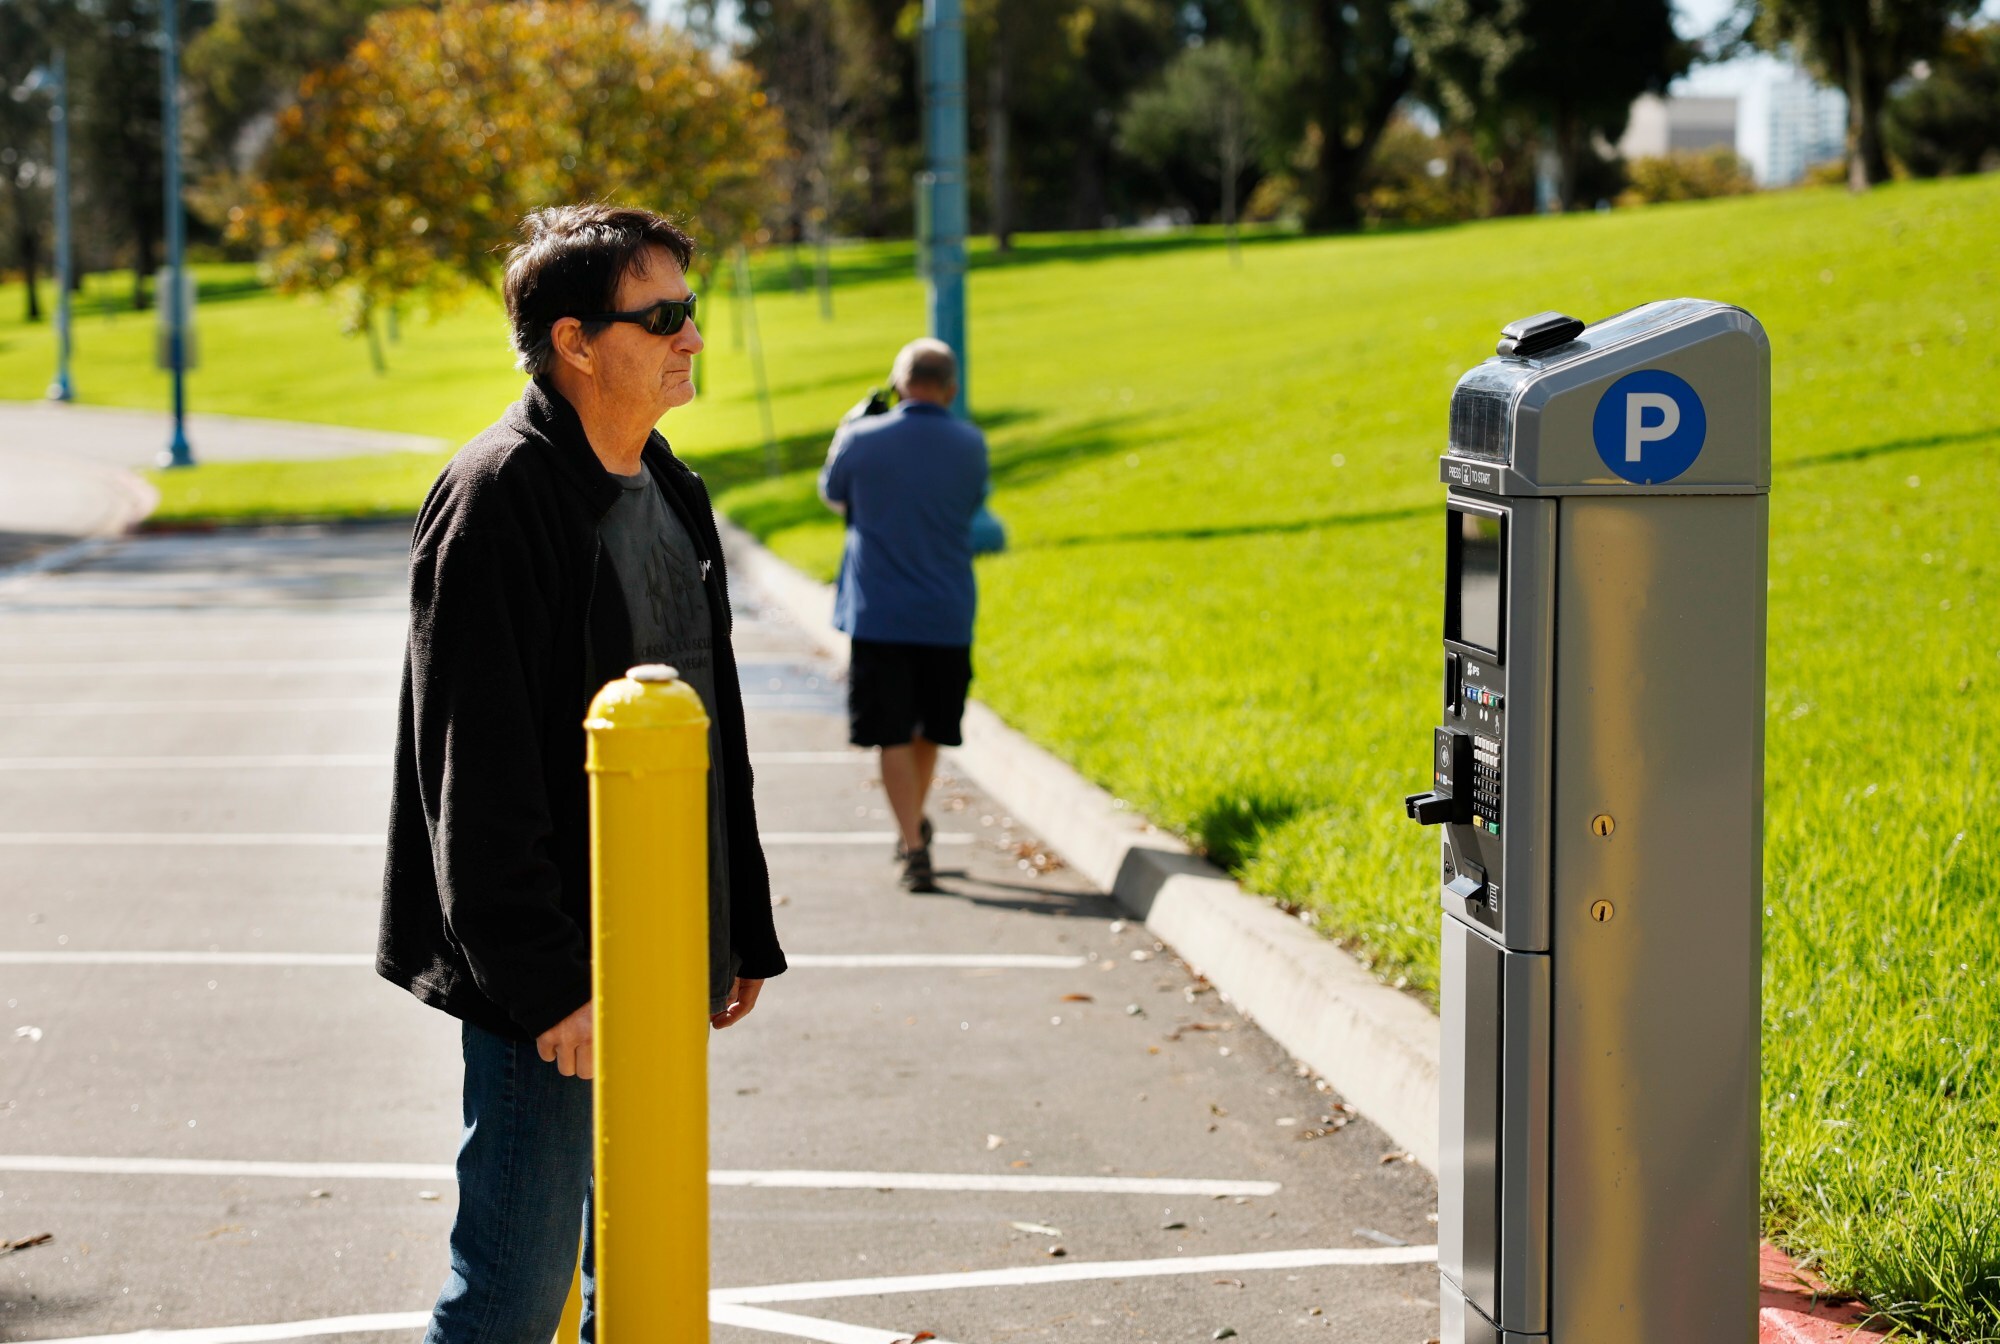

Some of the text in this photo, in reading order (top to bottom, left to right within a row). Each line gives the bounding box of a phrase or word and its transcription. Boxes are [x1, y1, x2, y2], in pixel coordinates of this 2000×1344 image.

[1625, 392, 1681, 462] P
[1448, 466, 1461, 479] PRESS
[1471, 470, 1477, 483] TO
[1478, 471, 1491, 485] START
